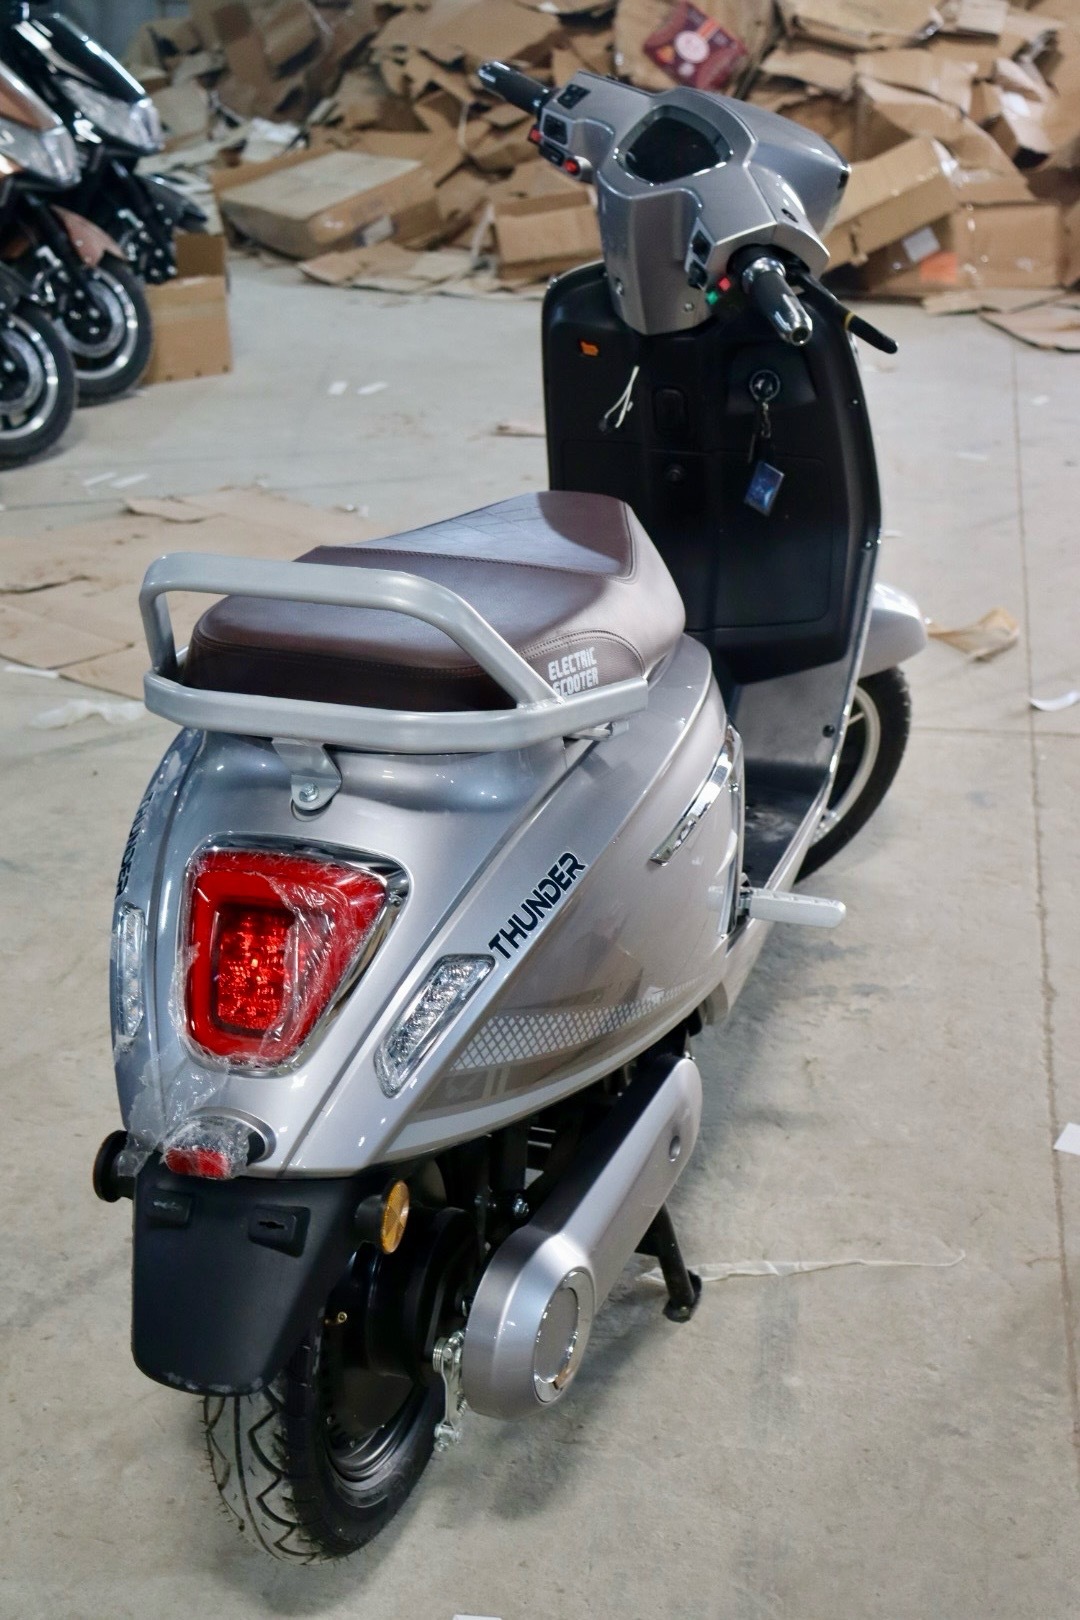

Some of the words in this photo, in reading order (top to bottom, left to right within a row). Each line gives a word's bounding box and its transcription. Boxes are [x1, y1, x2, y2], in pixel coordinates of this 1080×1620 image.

[548, 647, 597, 681] ELECTRIC
[552, 667, 599, 697] SCOOTER
[488, 852, 586, 959] THUNDER
